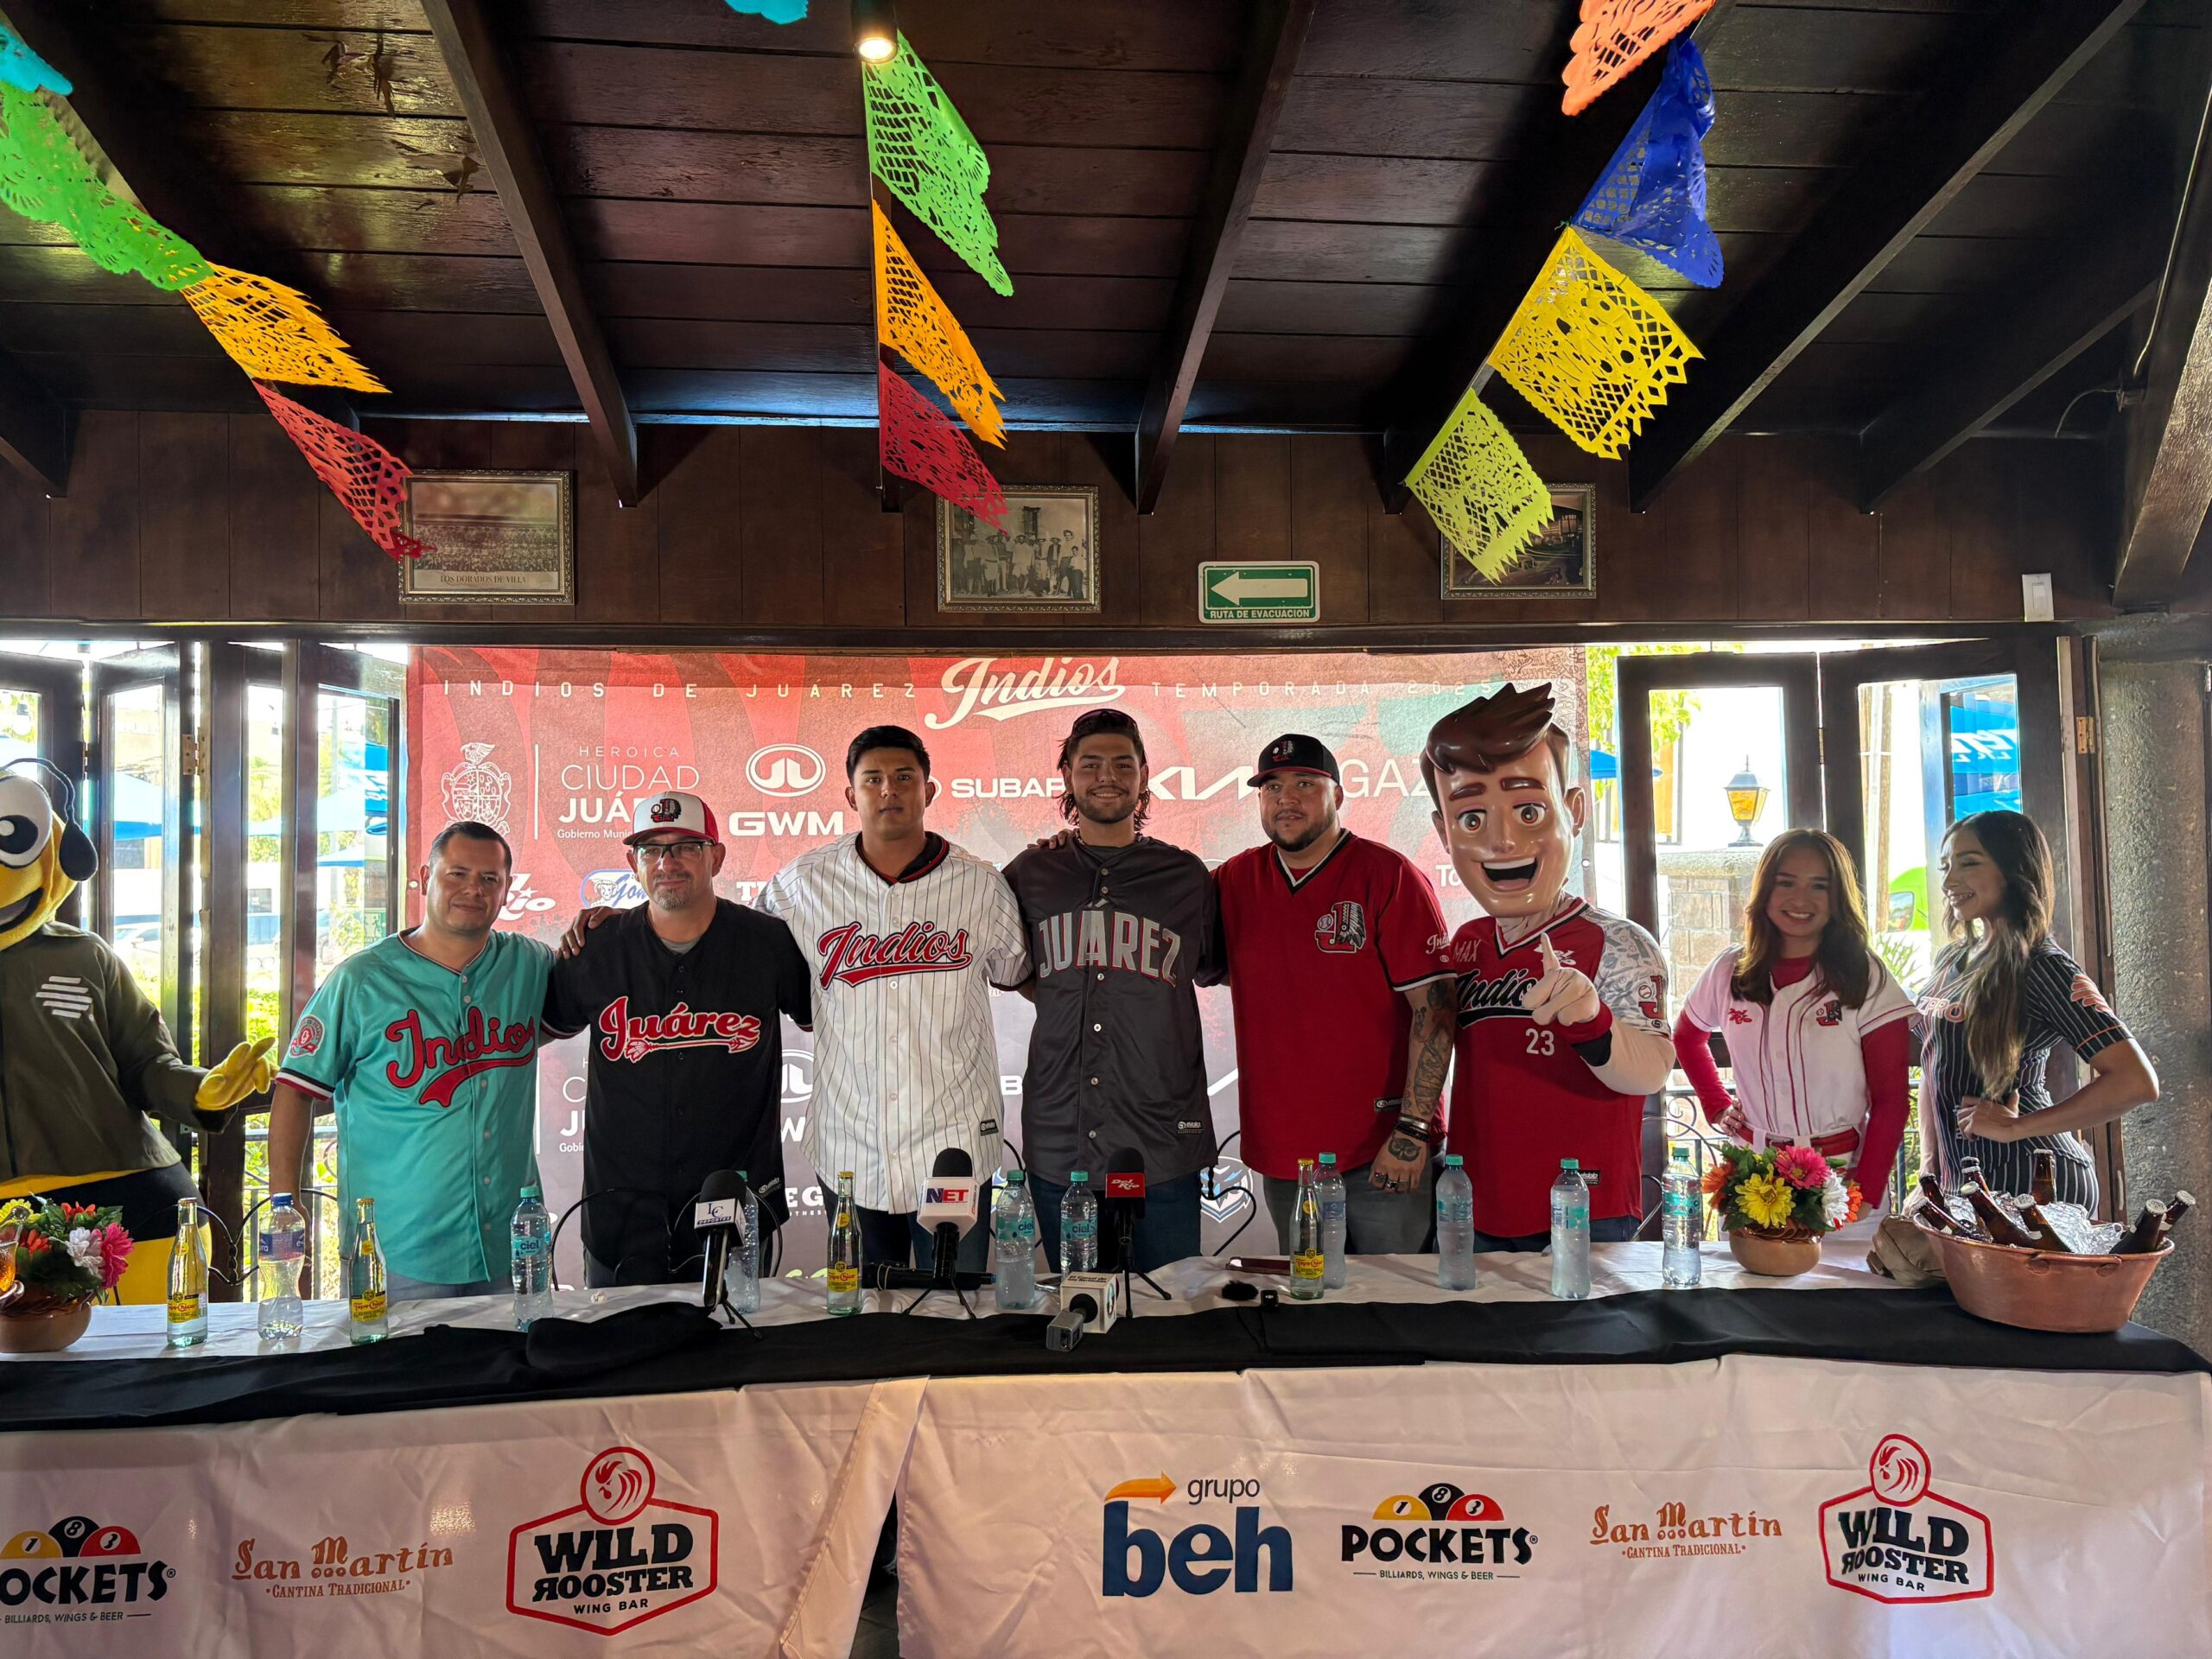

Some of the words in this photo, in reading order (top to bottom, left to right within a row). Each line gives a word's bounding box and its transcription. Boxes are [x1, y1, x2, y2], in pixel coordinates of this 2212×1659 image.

[1210, 610, 1234, 619] RUTA
[1236, 610, 1249, 619] DE
[1252, 609, 1310, 619] EVACUACION
[443, 679, 605, 698] INDIOS
[652, 683, 697, 698] DE
[746, 678, 915, 698] JUÁREZ
[924, 657, 1126, 730] Indios
[1152, 681, 1370, 699] TEMPORADA
[1406, 678, 1493, 696] 2025
[579, 747, 679, 758] HEROICA
[561, 764, 701, 791] CIUDAD
[950, 777, 1065, 798] SUBAR
[558, 791, 649, 824] JUÁ
[557, 829, 601, 839] Gobierno
[728, 810, 844, 836] GWM
[817, 920, 973, 990] Indios
[1454, 968, 1539, 1010] Indio
[599, 996, 761, 1060] Juárez
[1525, 1027, 1555, 1057] 23
[925, 1188, 969, 1204] NET
[1018, 1218, 1035, 1232] ciel
[1071, 1223, 1090, 1234] ciel
[519, 1239, 540, 1251] ciel
[1187, 1475, 1261, 1505] grupo
[1590, 1503, 1649, 1546] San
[1656, 1501, 1783, 1541] Martín
[1838, 1506, 1970, 1557] WILD
[232, 1537, 302, 1580] San
[310, 1535, 454, 1579] Martín
[533, 1522, 694, 1574] WILD
[1102, 1500, 1294, 1598] beh
[1625, 1545, 1671, 1560] CANTINA
[1672, 1542, 1743, 1557] TRADICIONAL
[1379, 1570, 1425, 1580] BILLIARDS,
[1427, 1571, 1459, 1580] WINGS
[1460, 1571, 1469, 1580] &
[1471, 1571, 1494, 1580] BEER
[1840, 1549, 1970, 1586] ROOSTER
[271, 1584, 324, 1599] CANTINA
[327, 1579, 406, 1596] TRADICIONAL
[531, 1566, 694, 1603] ROOSTER
[1858, 1572, 1891, 1585] WING
[1896, 1576, 1926, 1592] BAR
[4, 1614, 52, 1624] BILLIARDS,
[54, 1613, 87, 1623] WINGS
[89, 1611, 99, 1622] &
[99, 1611, 124, 1621] BEER
[574, 1603, 612, 1615] WING
[618, 1599, 649, 1611] BAR
